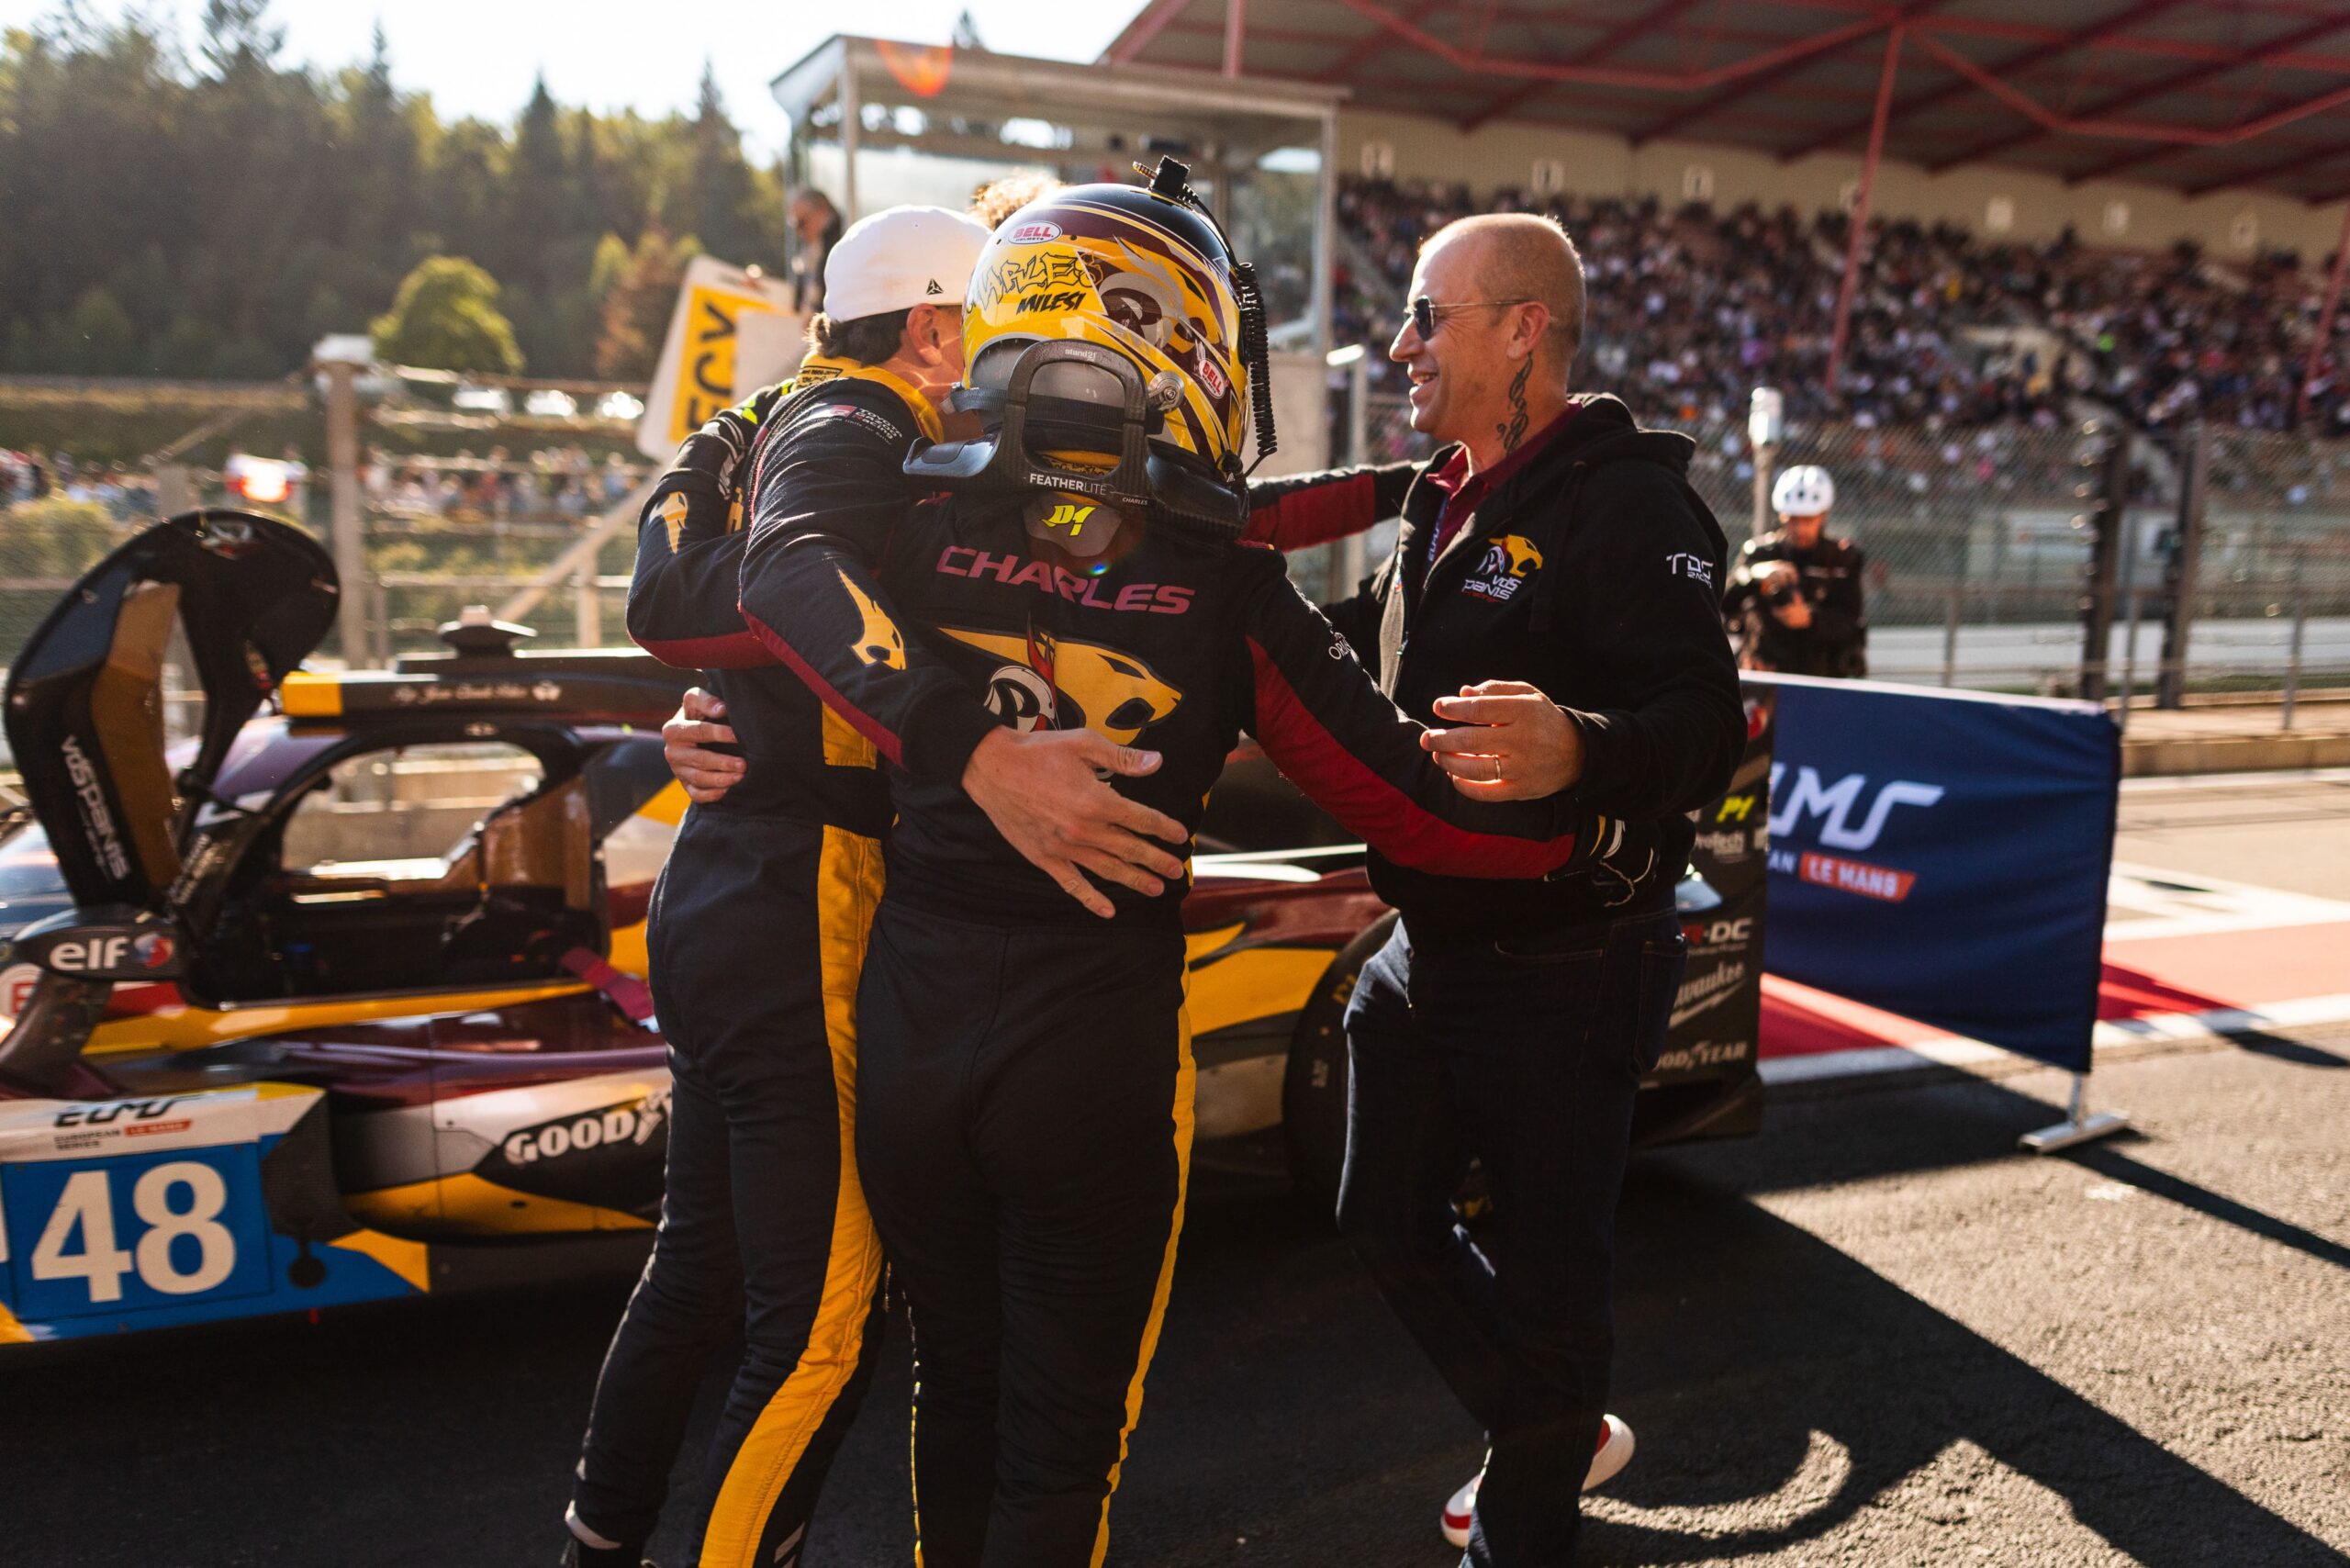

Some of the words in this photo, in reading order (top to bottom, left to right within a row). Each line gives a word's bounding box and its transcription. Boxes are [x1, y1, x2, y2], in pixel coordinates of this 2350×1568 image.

[1013, 226, 1054, 239] BELL
[1015, 290, 1087, 315] MILESI
[1203, 361, 1222, 395] BELL
[858, 408, 903, 438] TOYOTA
[1029, 473, 1107, 496] FEATHERLITE
[1122, 497, 1148, 506] CHARLES
[935, 544, 1196, 615] CHARLES
[1666, 553, 1714, 581] TDS
[1768, 762, 1945, 851] LMS
[1808, 855, 1833, 883] LE
[1838, 862, 1898, 899] MANS
[50, 936, 129, 971] elf
[54, 1128, 120, 1143] EUROPEAN
[505, 1091, 673, 1167] GOOD
[31, 1159, 237, 1304] 48
